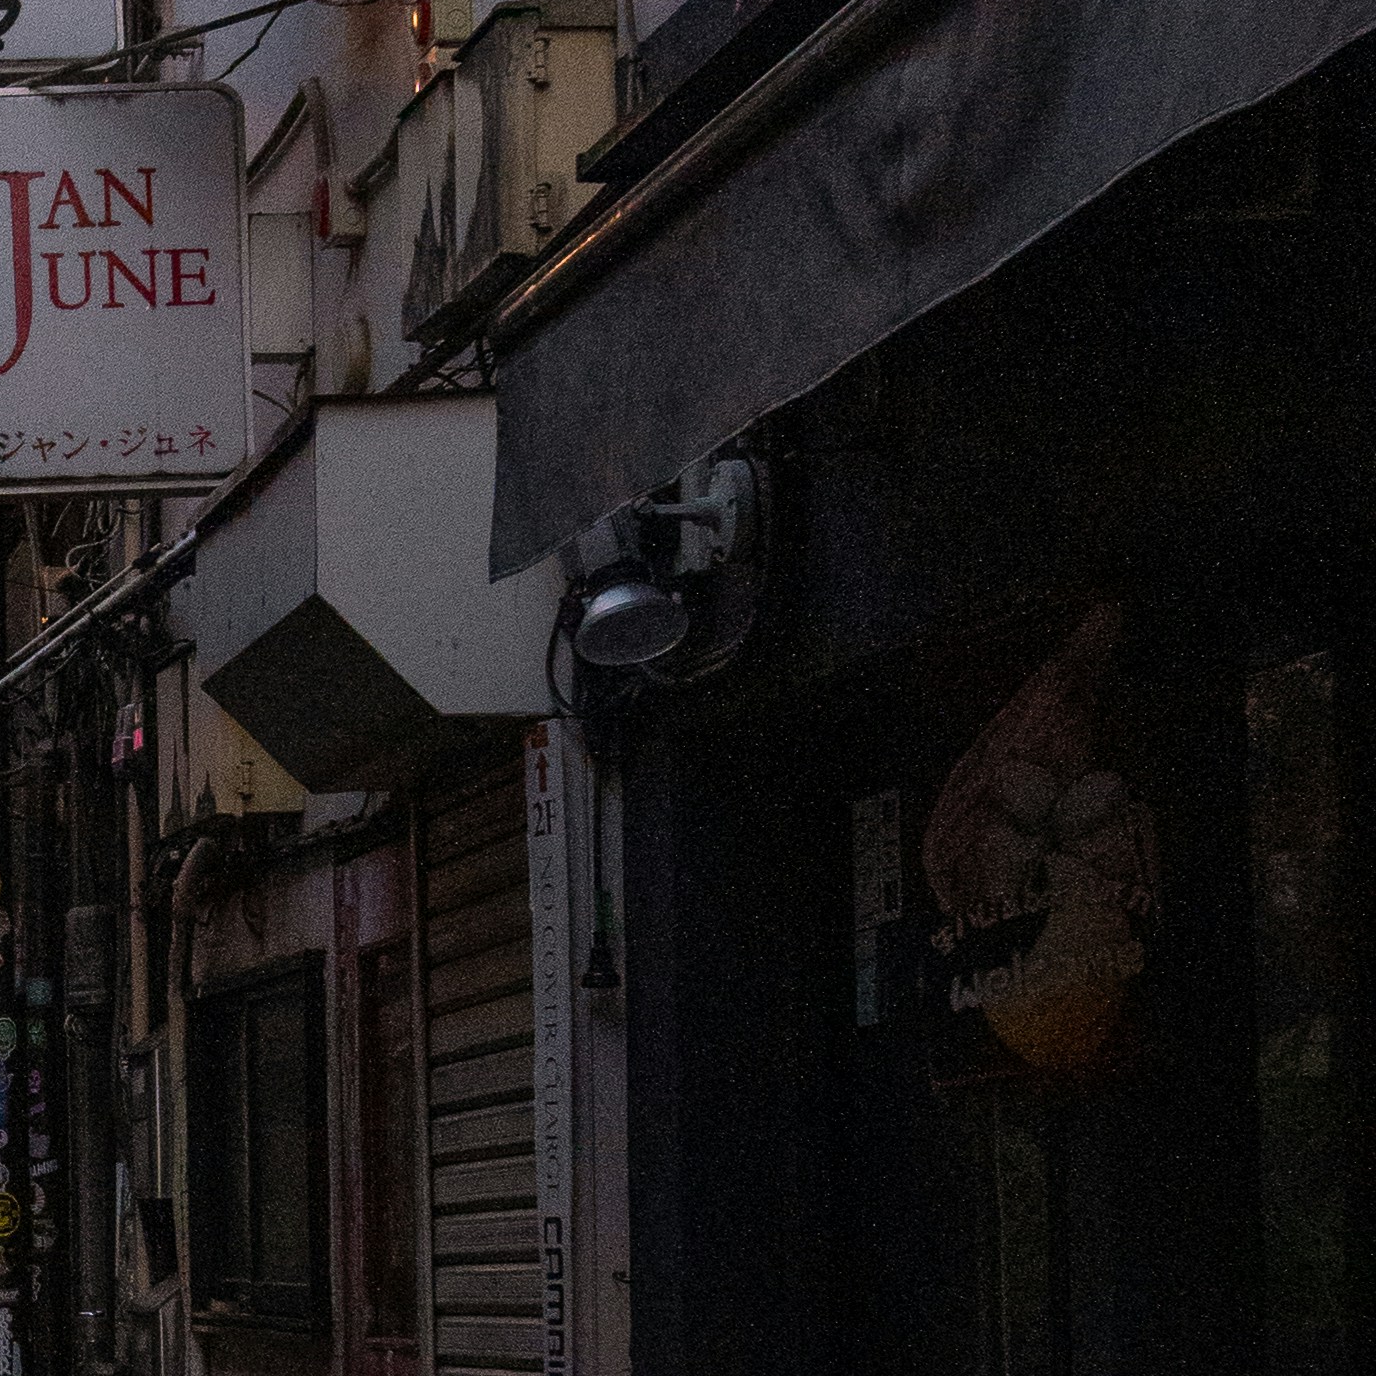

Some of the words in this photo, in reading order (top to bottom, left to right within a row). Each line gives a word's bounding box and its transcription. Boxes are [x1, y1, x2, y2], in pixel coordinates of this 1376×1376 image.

[539, 853, 557, 910] NO
[541, 926, 560, 1043] COVER
[544, 1058, 562, 1202] CHARGE
